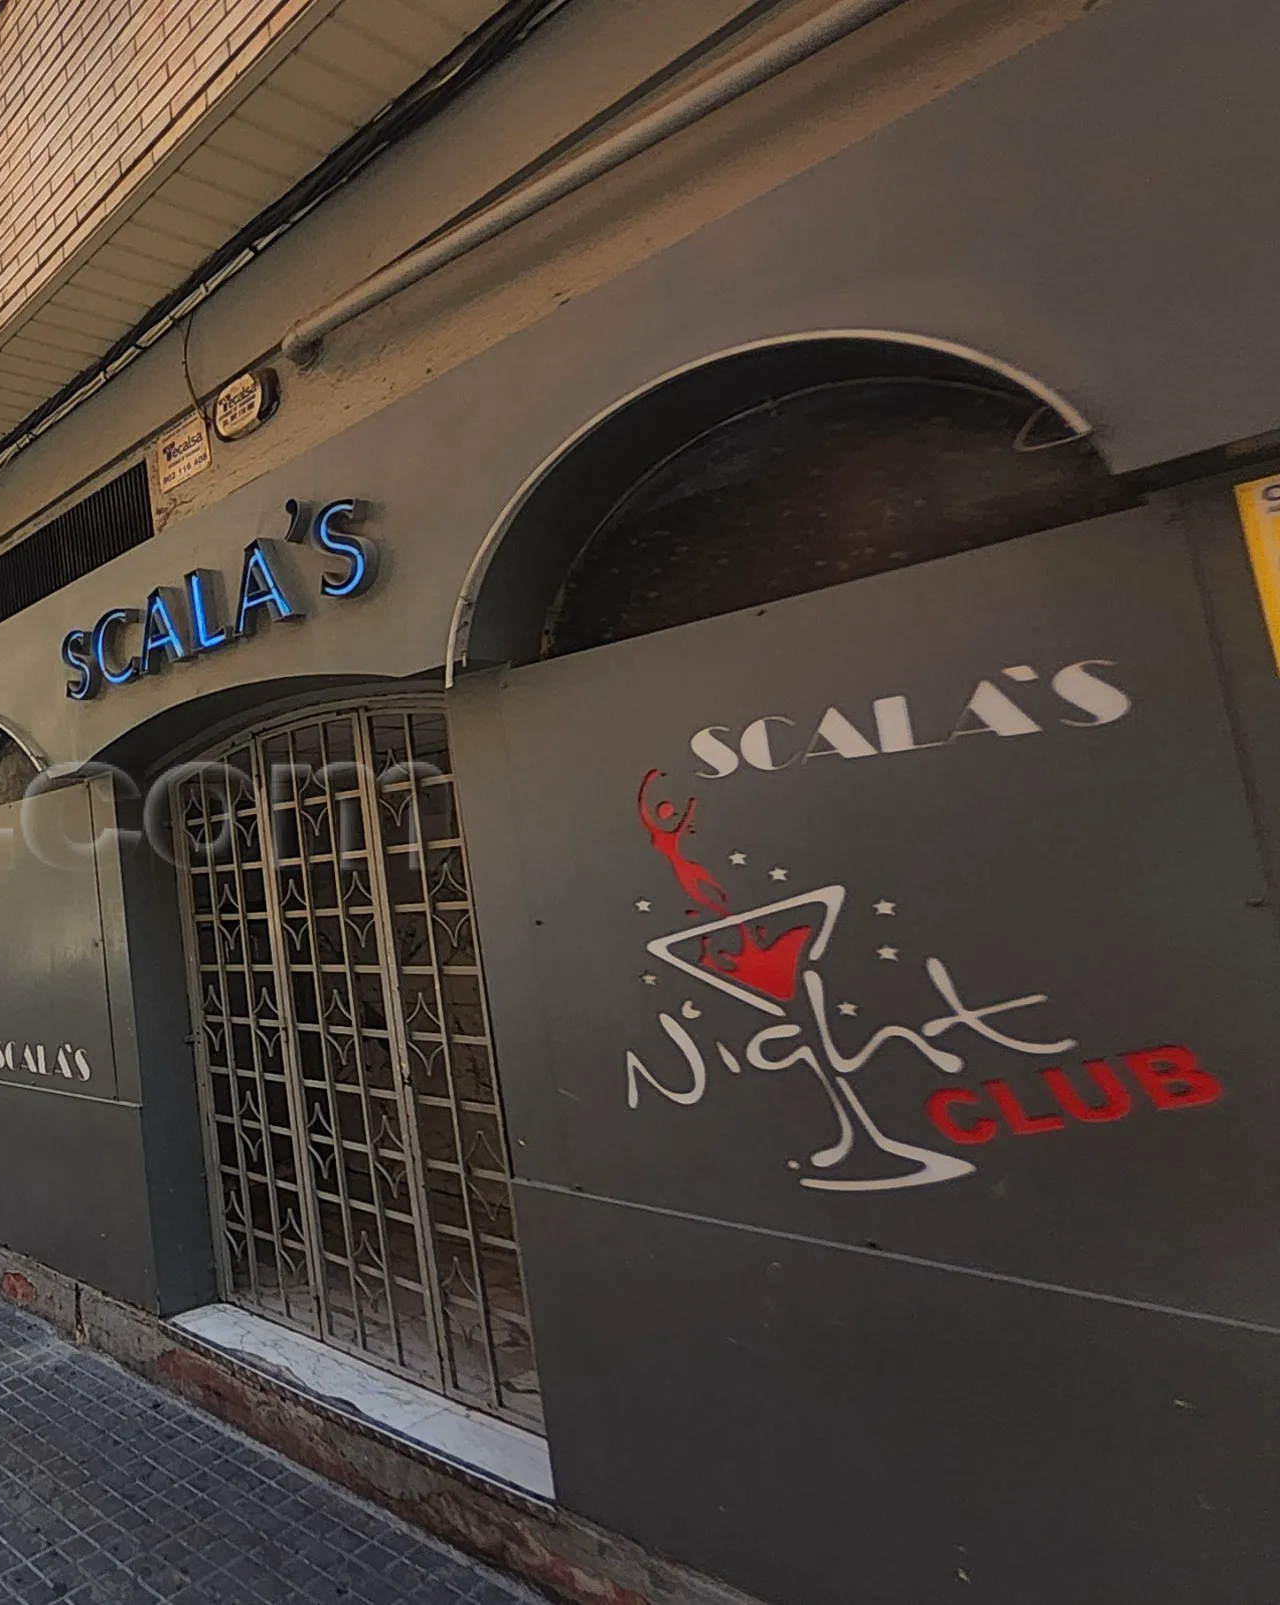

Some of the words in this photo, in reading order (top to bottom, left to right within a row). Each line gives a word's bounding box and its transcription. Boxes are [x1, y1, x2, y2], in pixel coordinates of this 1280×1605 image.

[162, 432, 203, 462] Tecalsa
[218, 384, 257, 412] Tecalsa
[62, 498, 374, 700] SCALA'S
[689, 659, 1132, 780] SCALA'S
[626, 957, 1077, 1168] Night
[925, 1044, 1222, 1146] CLUB
